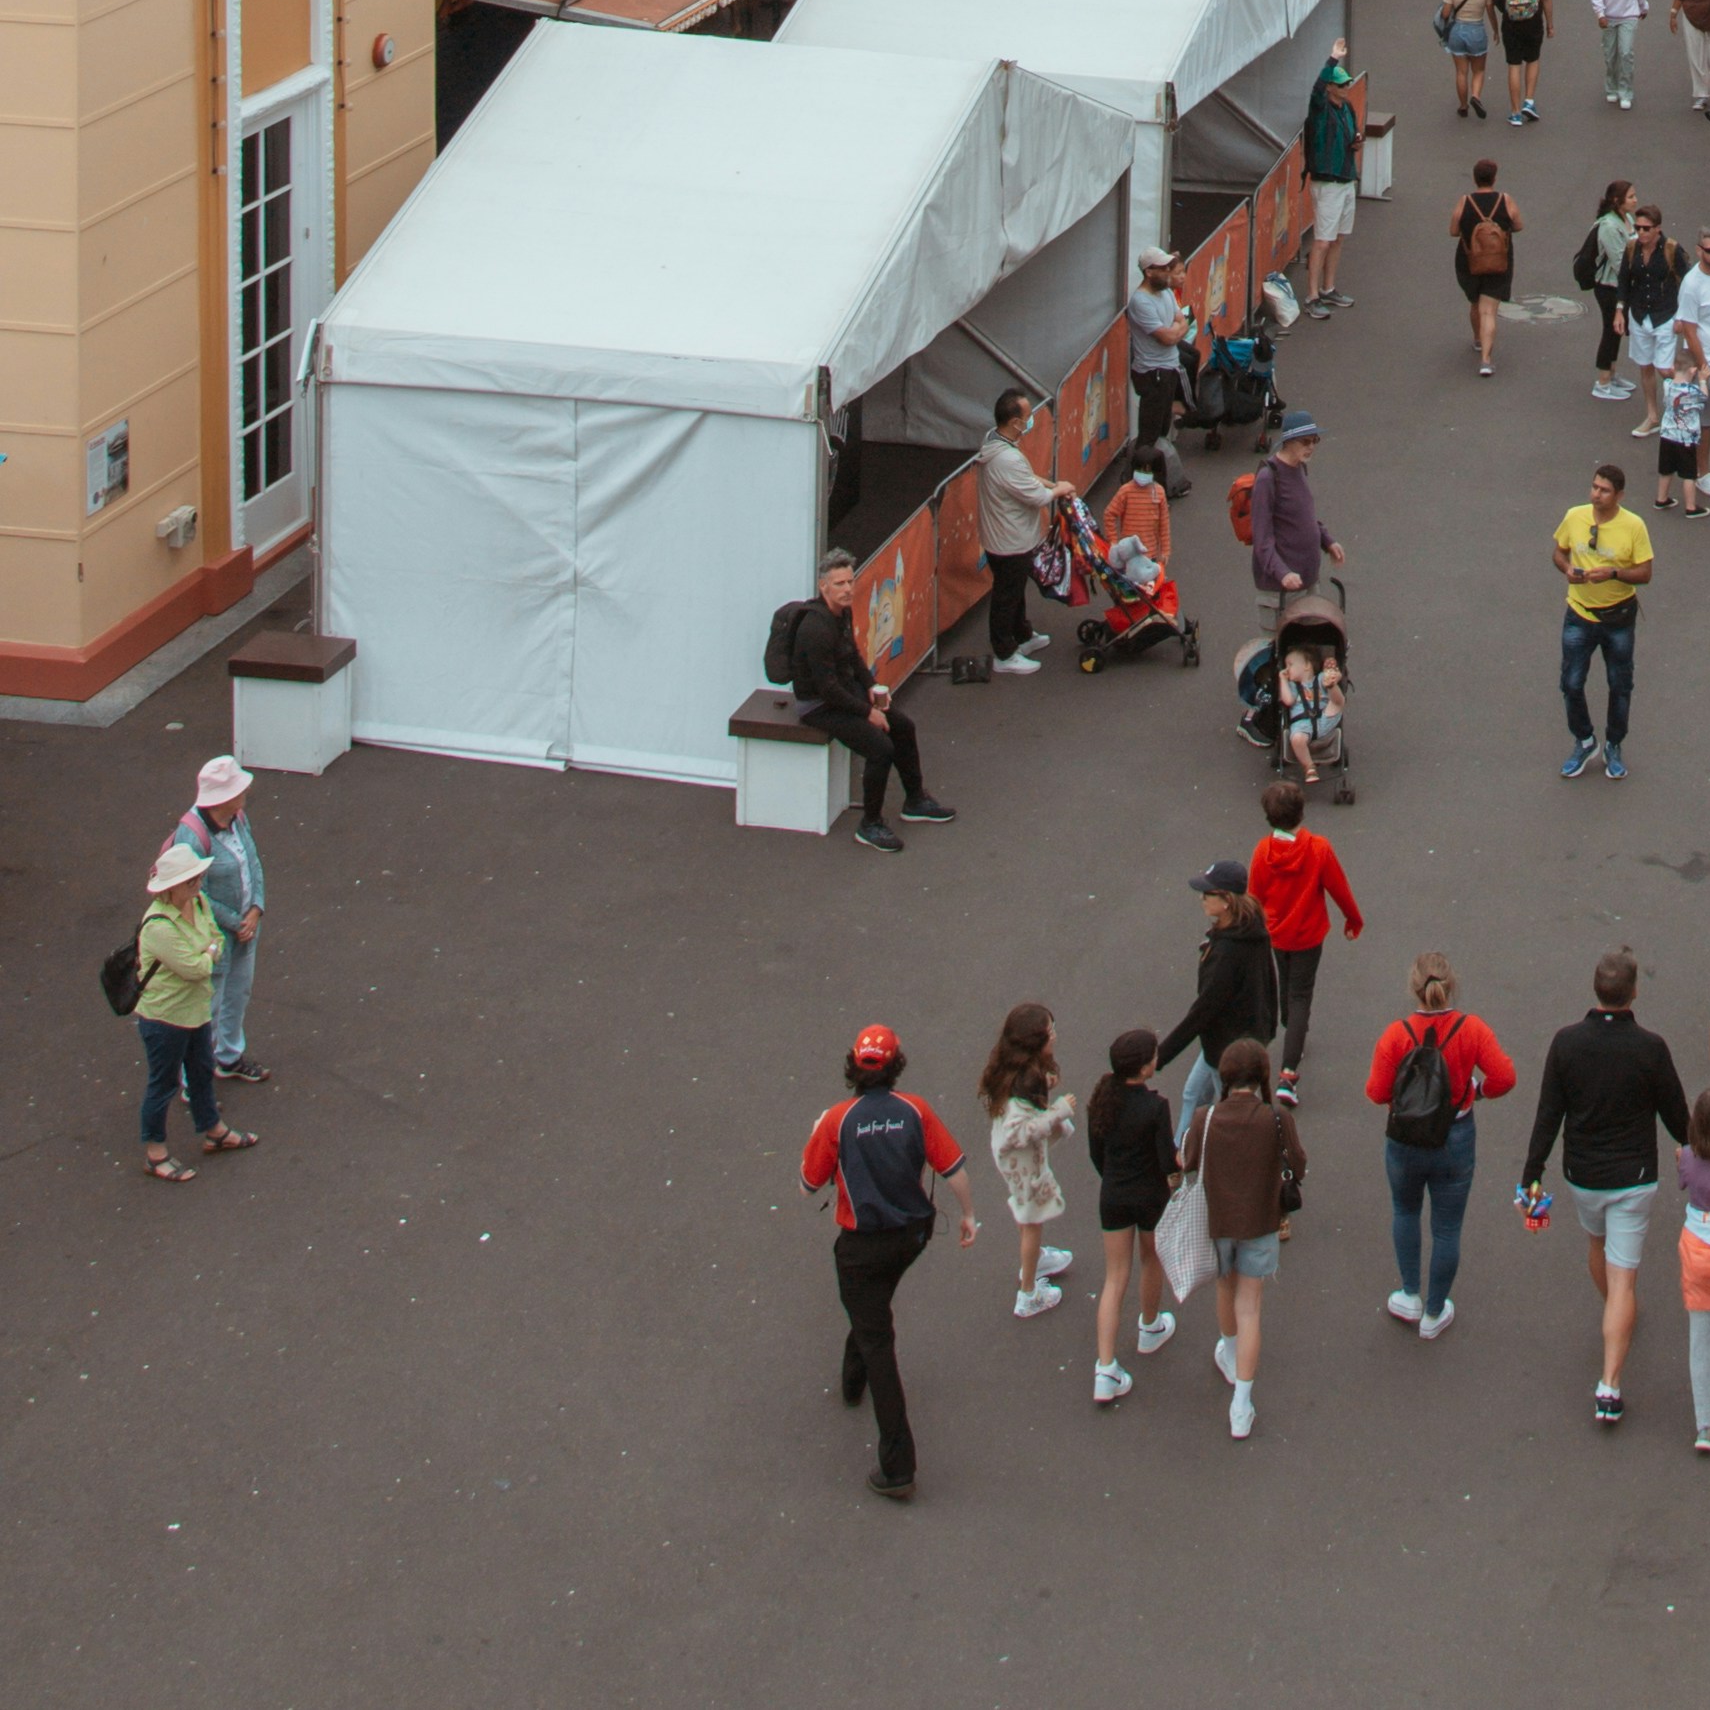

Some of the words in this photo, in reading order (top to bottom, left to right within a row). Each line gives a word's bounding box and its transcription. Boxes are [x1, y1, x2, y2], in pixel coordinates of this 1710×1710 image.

[856, 1122, 871, 1138] just
[871, 1120, 885, 1136] for
[885, 1118, 905, 1134] fun!
